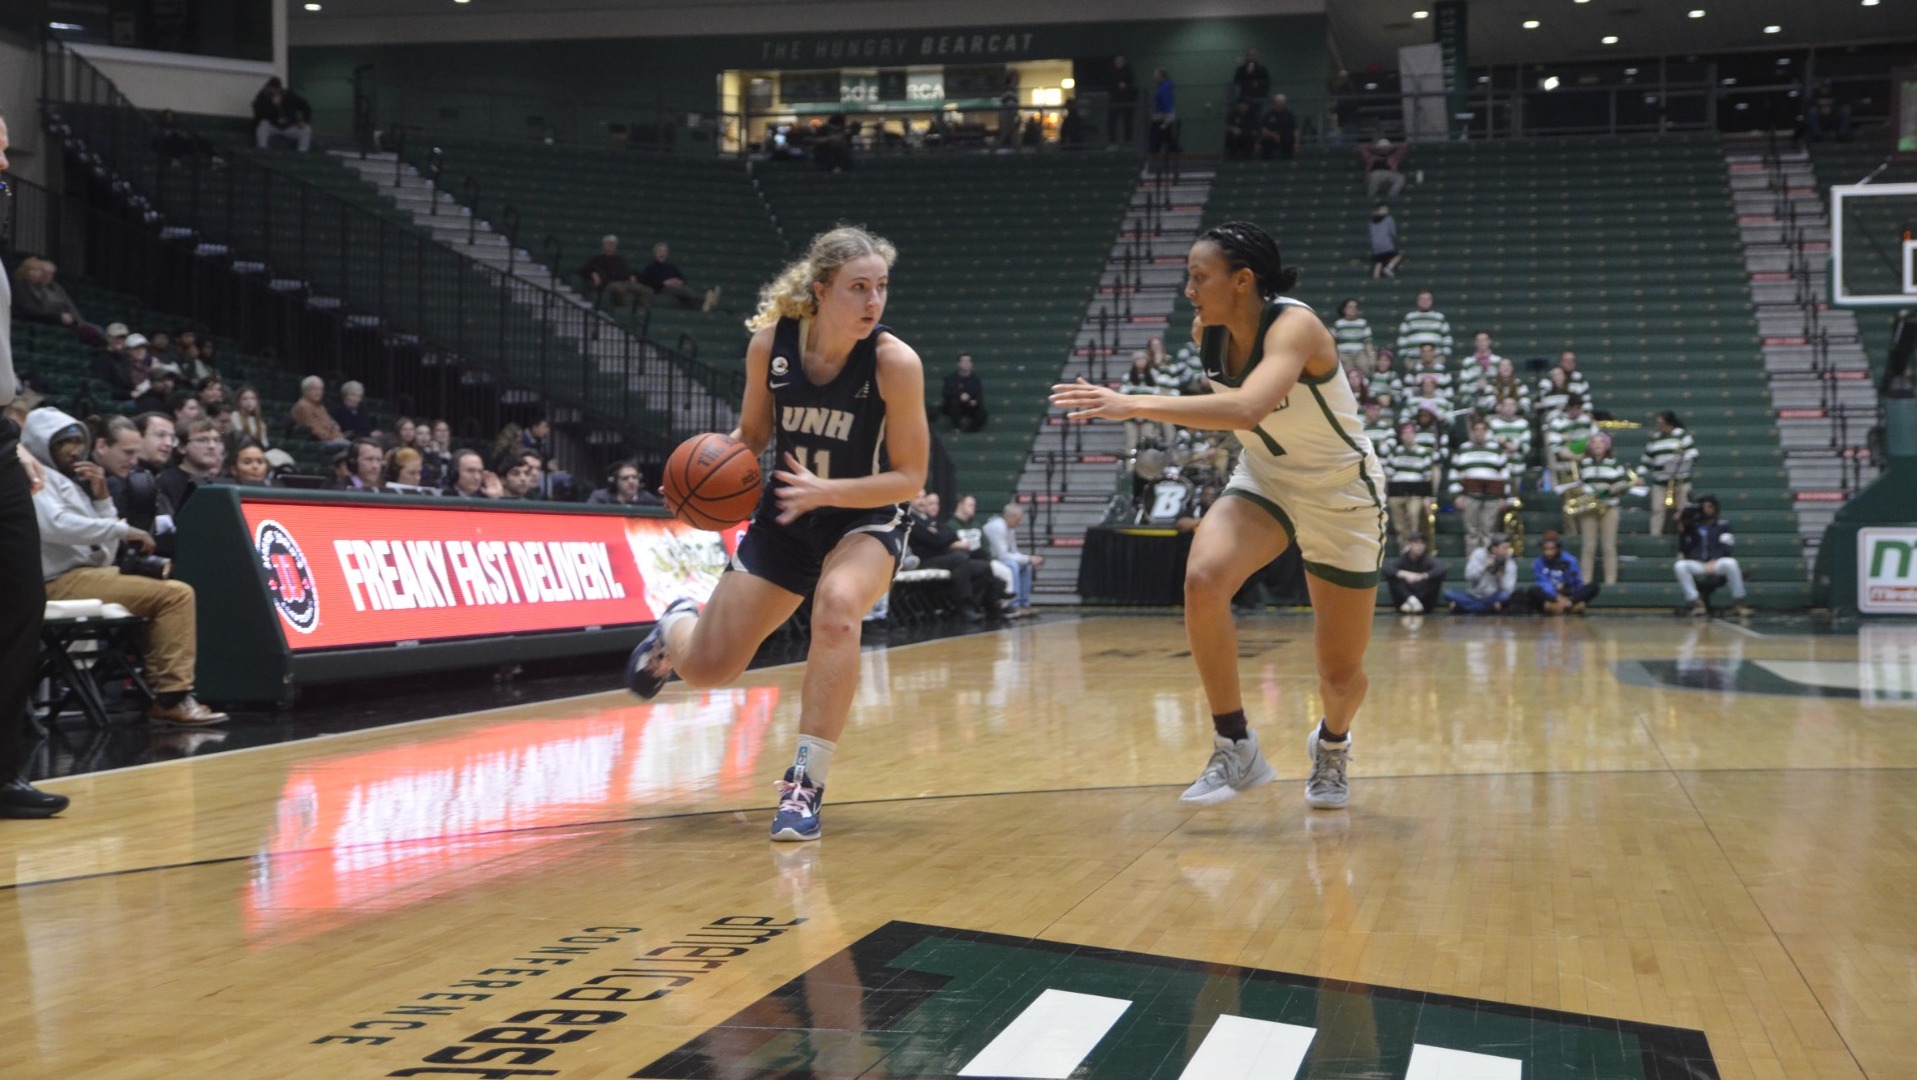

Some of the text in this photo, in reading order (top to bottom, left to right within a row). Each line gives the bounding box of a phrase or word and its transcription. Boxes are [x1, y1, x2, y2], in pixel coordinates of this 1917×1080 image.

[761, 33, 1034, 60] THE HUNGRY BEARCAT
[781, 406, 855, 442] UNH
[1150, 482, 1187, 518] B
[333, 539, 457, 611] FREAKY
[445, 541, 520, 606] FAST
[507, 541, 625, 603] DELIVERY.
[310, 926, 642, 1046] CONFERENCE
